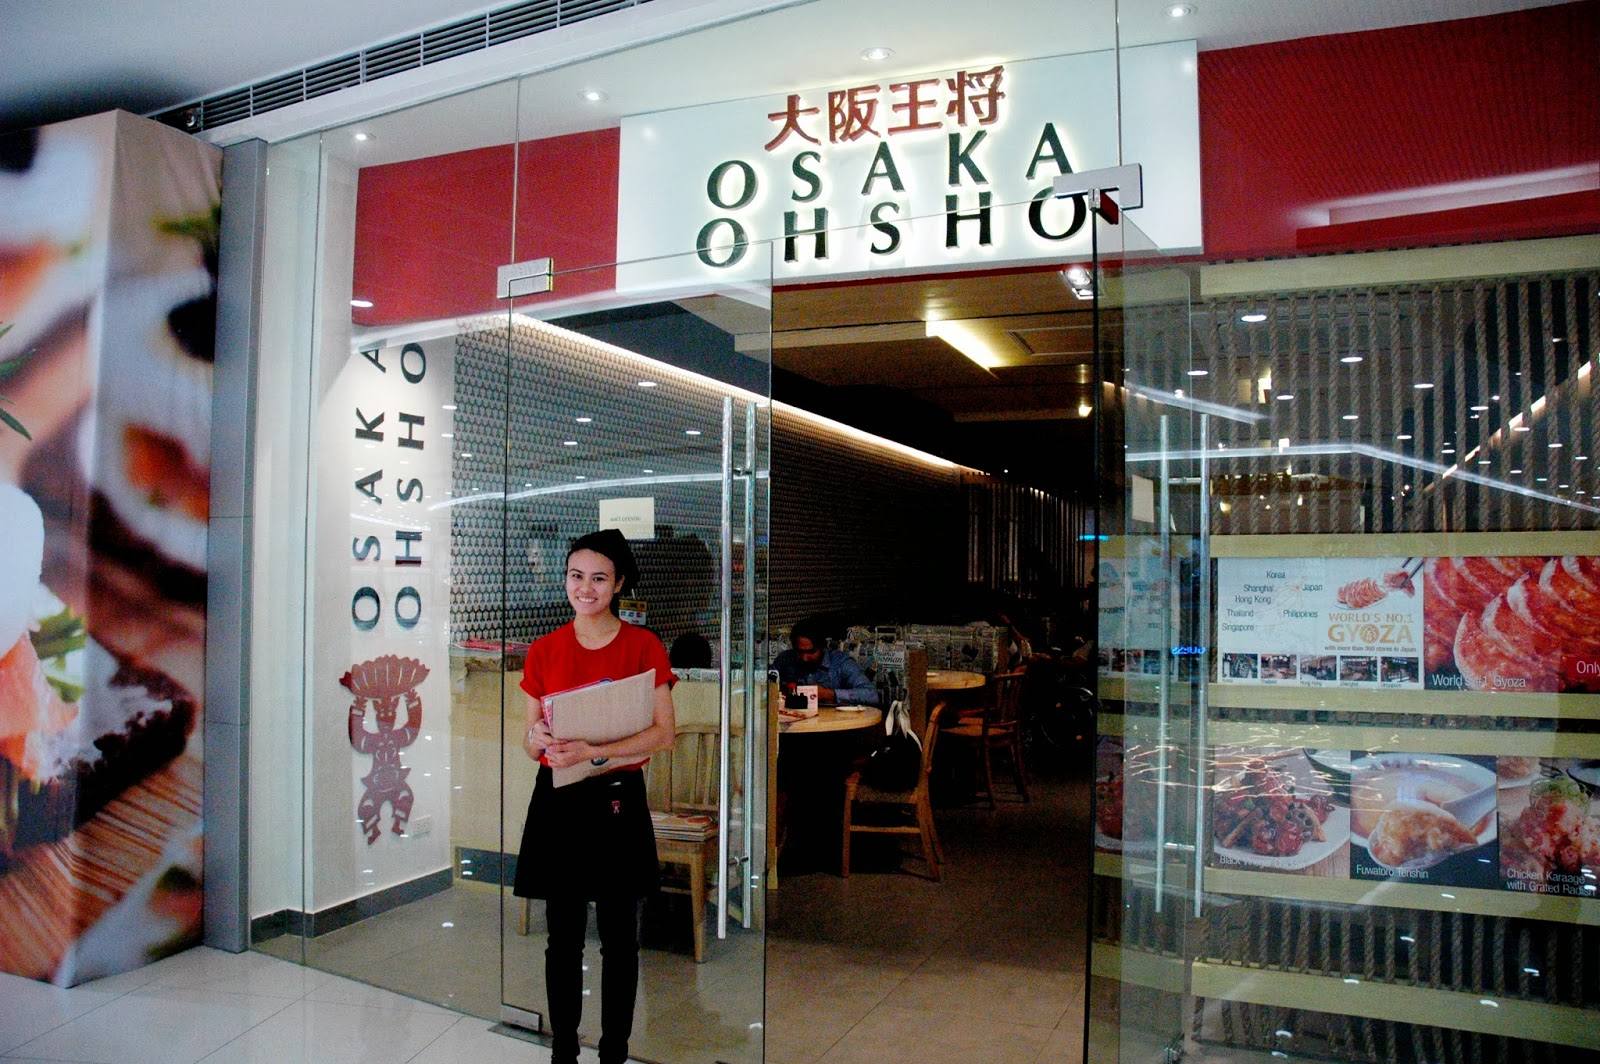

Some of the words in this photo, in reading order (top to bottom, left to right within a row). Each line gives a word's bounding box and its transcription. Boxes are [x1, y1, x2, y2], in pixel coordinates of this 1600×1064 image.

[764, 65, 1007, 151] 大阪王将
[706, 122, 1075, 210] OSAKA
[696, 187, 1087, 269] OHSHO
[352, 339, 387, 632] OSAKA
[394, 342, 427, 630] OHSHO
[1266, 570, 1286, 579] Korea
[1243, 583, 1274, 594] Shanghai
[1301, 583, 1323, 592] Japan
[1235, 595, 1253, 605] Hong
[1254, 595, 1272, 605] Kong
[1226, 608, 1254, 618] Thailand
[1283, 609, 1318, 619] Philippines
[1328, 612, 1382, 623] WORLD'S
[1386, 613, 1414, 624] NO.1
[1221, 622, 1255, 632] Singapore
[1327, 623, 1414, 644] GYOZA
[1431, 674, 1470, 687] World's
[1493, 675, 1526, 688] Gyoza
[1356, 864, 1395, 877] Fuwatoro
[1397, 867, 1429, 879] Tenshin
[1506, 868, 1543, 880] Chicken
[1546, 871, 1585, 885] Karaage
[1506, 881, 1526, 891] with
[1528, 881, 1560, 893] Grated
